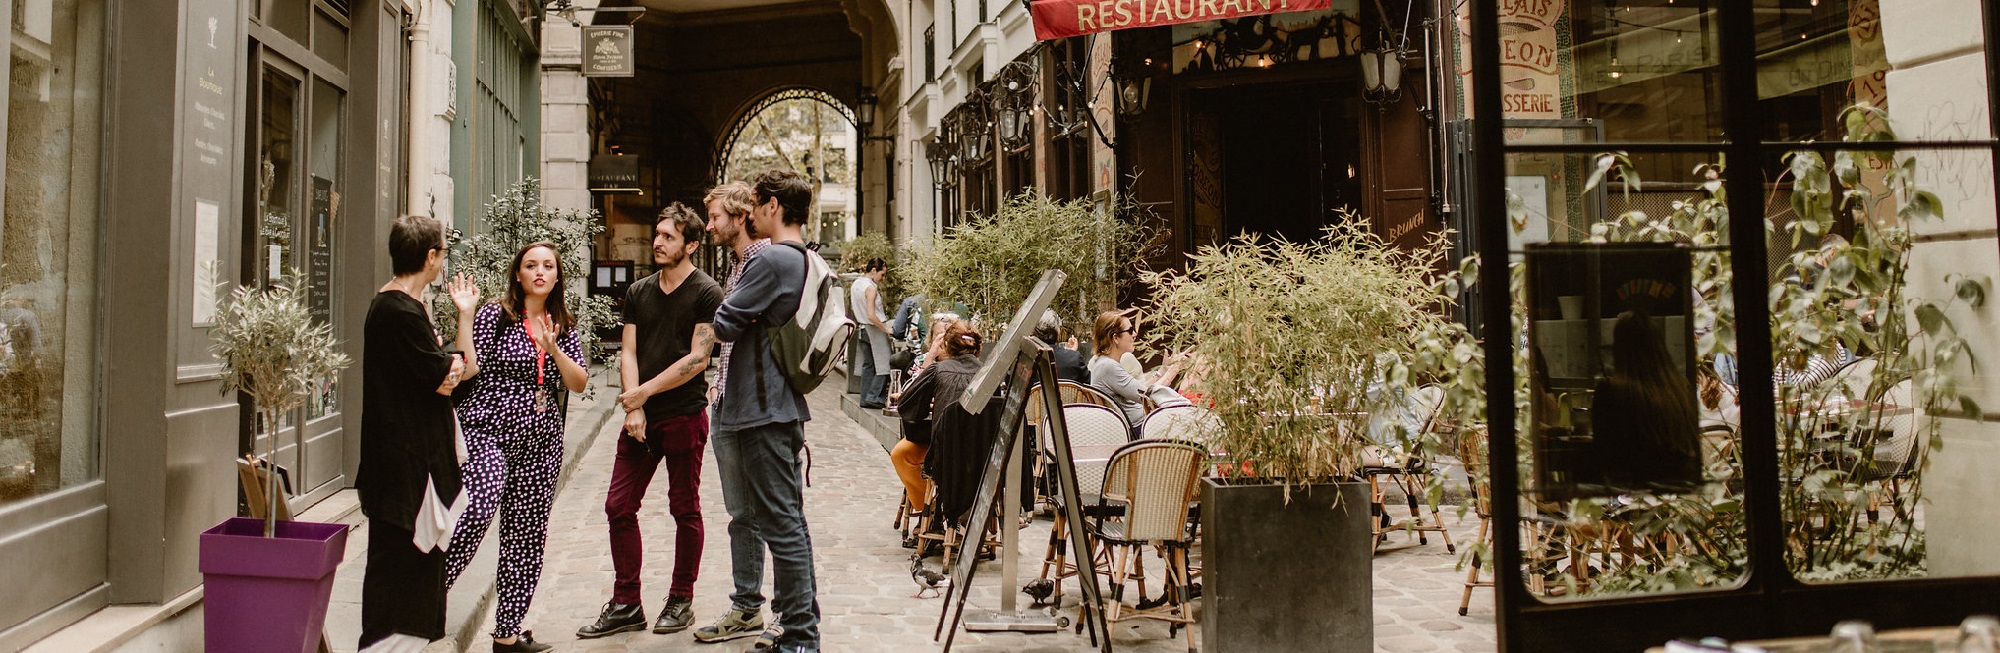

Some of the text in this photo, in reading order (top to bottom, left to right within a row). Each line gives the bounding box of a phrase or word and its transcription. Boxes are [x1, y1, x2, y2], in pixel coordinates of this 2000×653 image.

[1498, 0, 1552, 17] LAIS
[1503, 39, 1554, 68] EON
[1501, 93, 1553, 113] SSERIE
[1389, 208, 1424, 243] BRUNCH
